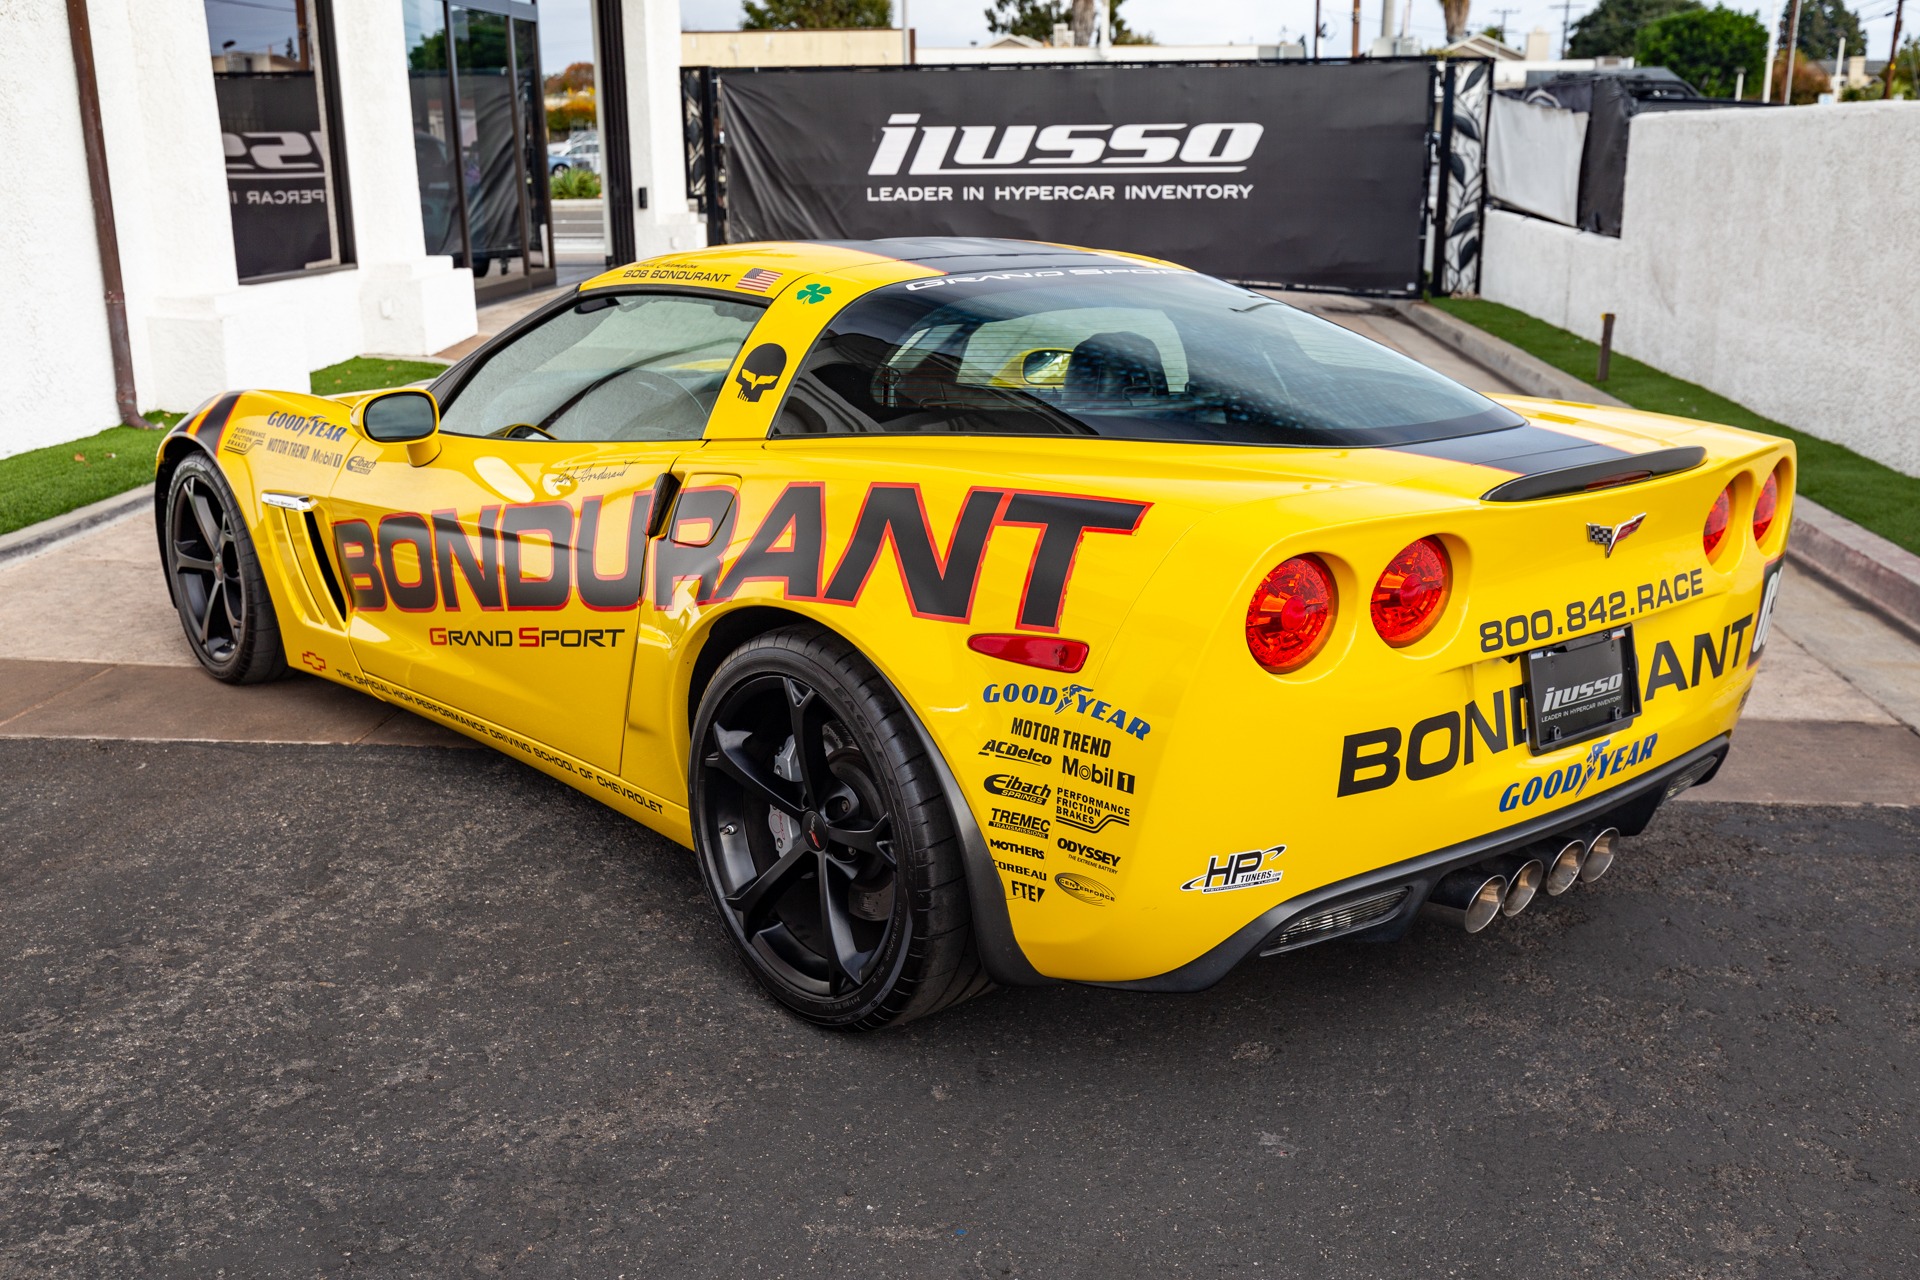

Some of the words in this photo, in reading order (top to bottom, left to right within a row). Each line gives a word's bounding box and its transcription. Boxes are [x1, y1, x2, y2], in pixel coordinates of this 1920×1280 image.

[867, 187, 953, 202] LEADER
[963, 187, 984, 201] IN
[994, 185, 1115, 200] HYPERCAR
[1124, 184, 1253, 200] INVENTORY
[623, 269, 650, 279] BOB
[650, 270, 732, 283] BONDURANT
[905, 270, 1065, 291] GRAND
[267, 411, 348, 442] GOODYEAR
[227, 439, 247, 449] BRAKES
[267, 437, 288, 455] MOTOR
[288, 442, 310, 460] TREND
[311, 449, 333, 467] Mobil
[330, 481, 1155, 634] BONDURANT
[1479, 568, 1704, 653] 800.842.RACE
[429, 627, 513, 647] GRAND
[519, 627, 626, 648] SPORT
[983, 683, 1151, 741] GOODYEAR
[1541, 711, 1562, 723] LEADER
[1570, 702, 1596, 715] HYPERCAR
[1597, 694, 1622, 708] INVENTORY
[337, 669, 353, 682] THE
[354, 676, 392, 695] OFFICIAL
[392, 688, 415, 704] HIGH
[416, 698, 488, 735] PERFORMANCE
[489, 729, 532, 754] DRIVING
[533, 747, 578, 774] SCHOOL
[579, 767, 594, 780] OF
[596, 775, 664, 815] CHEVROLET
[1011, 717, 1060, 746] MOTOR
[1063, 730, 1112, 758] TREND
[982, 739, 1052, 765] ACDelco
[1062, 755, 1114, 788] Mobil
[1499, 733, 1659, 813] GOODYEAR
[983, 774, 1052, 798] Eibach
[1001, 789, 1045, 805] SPRINGS
[1056, 797, 1101, 817] FRICTION
[1057, 787, 1130, 817] PERFORMANCE
[991, 808, 1051, 833] TREMEC
[1056, 806, 1095, 825] BRAKES
[993, 822, 1046, 838] TRANSMISSIONS
[989, 839, 1045, 860] MOTHERS
[1057, 838, 1121, 867] ODYSSEY
[1077, 857, 1098, 869] EXTREME
[1098, 864, 1119, 874] BATTERY
[1204, 850, 1263, 887] HP
[1240, 870, 1273, 883] TUNERS
[1059, 877, 1116, 903] CENTERFORCE
